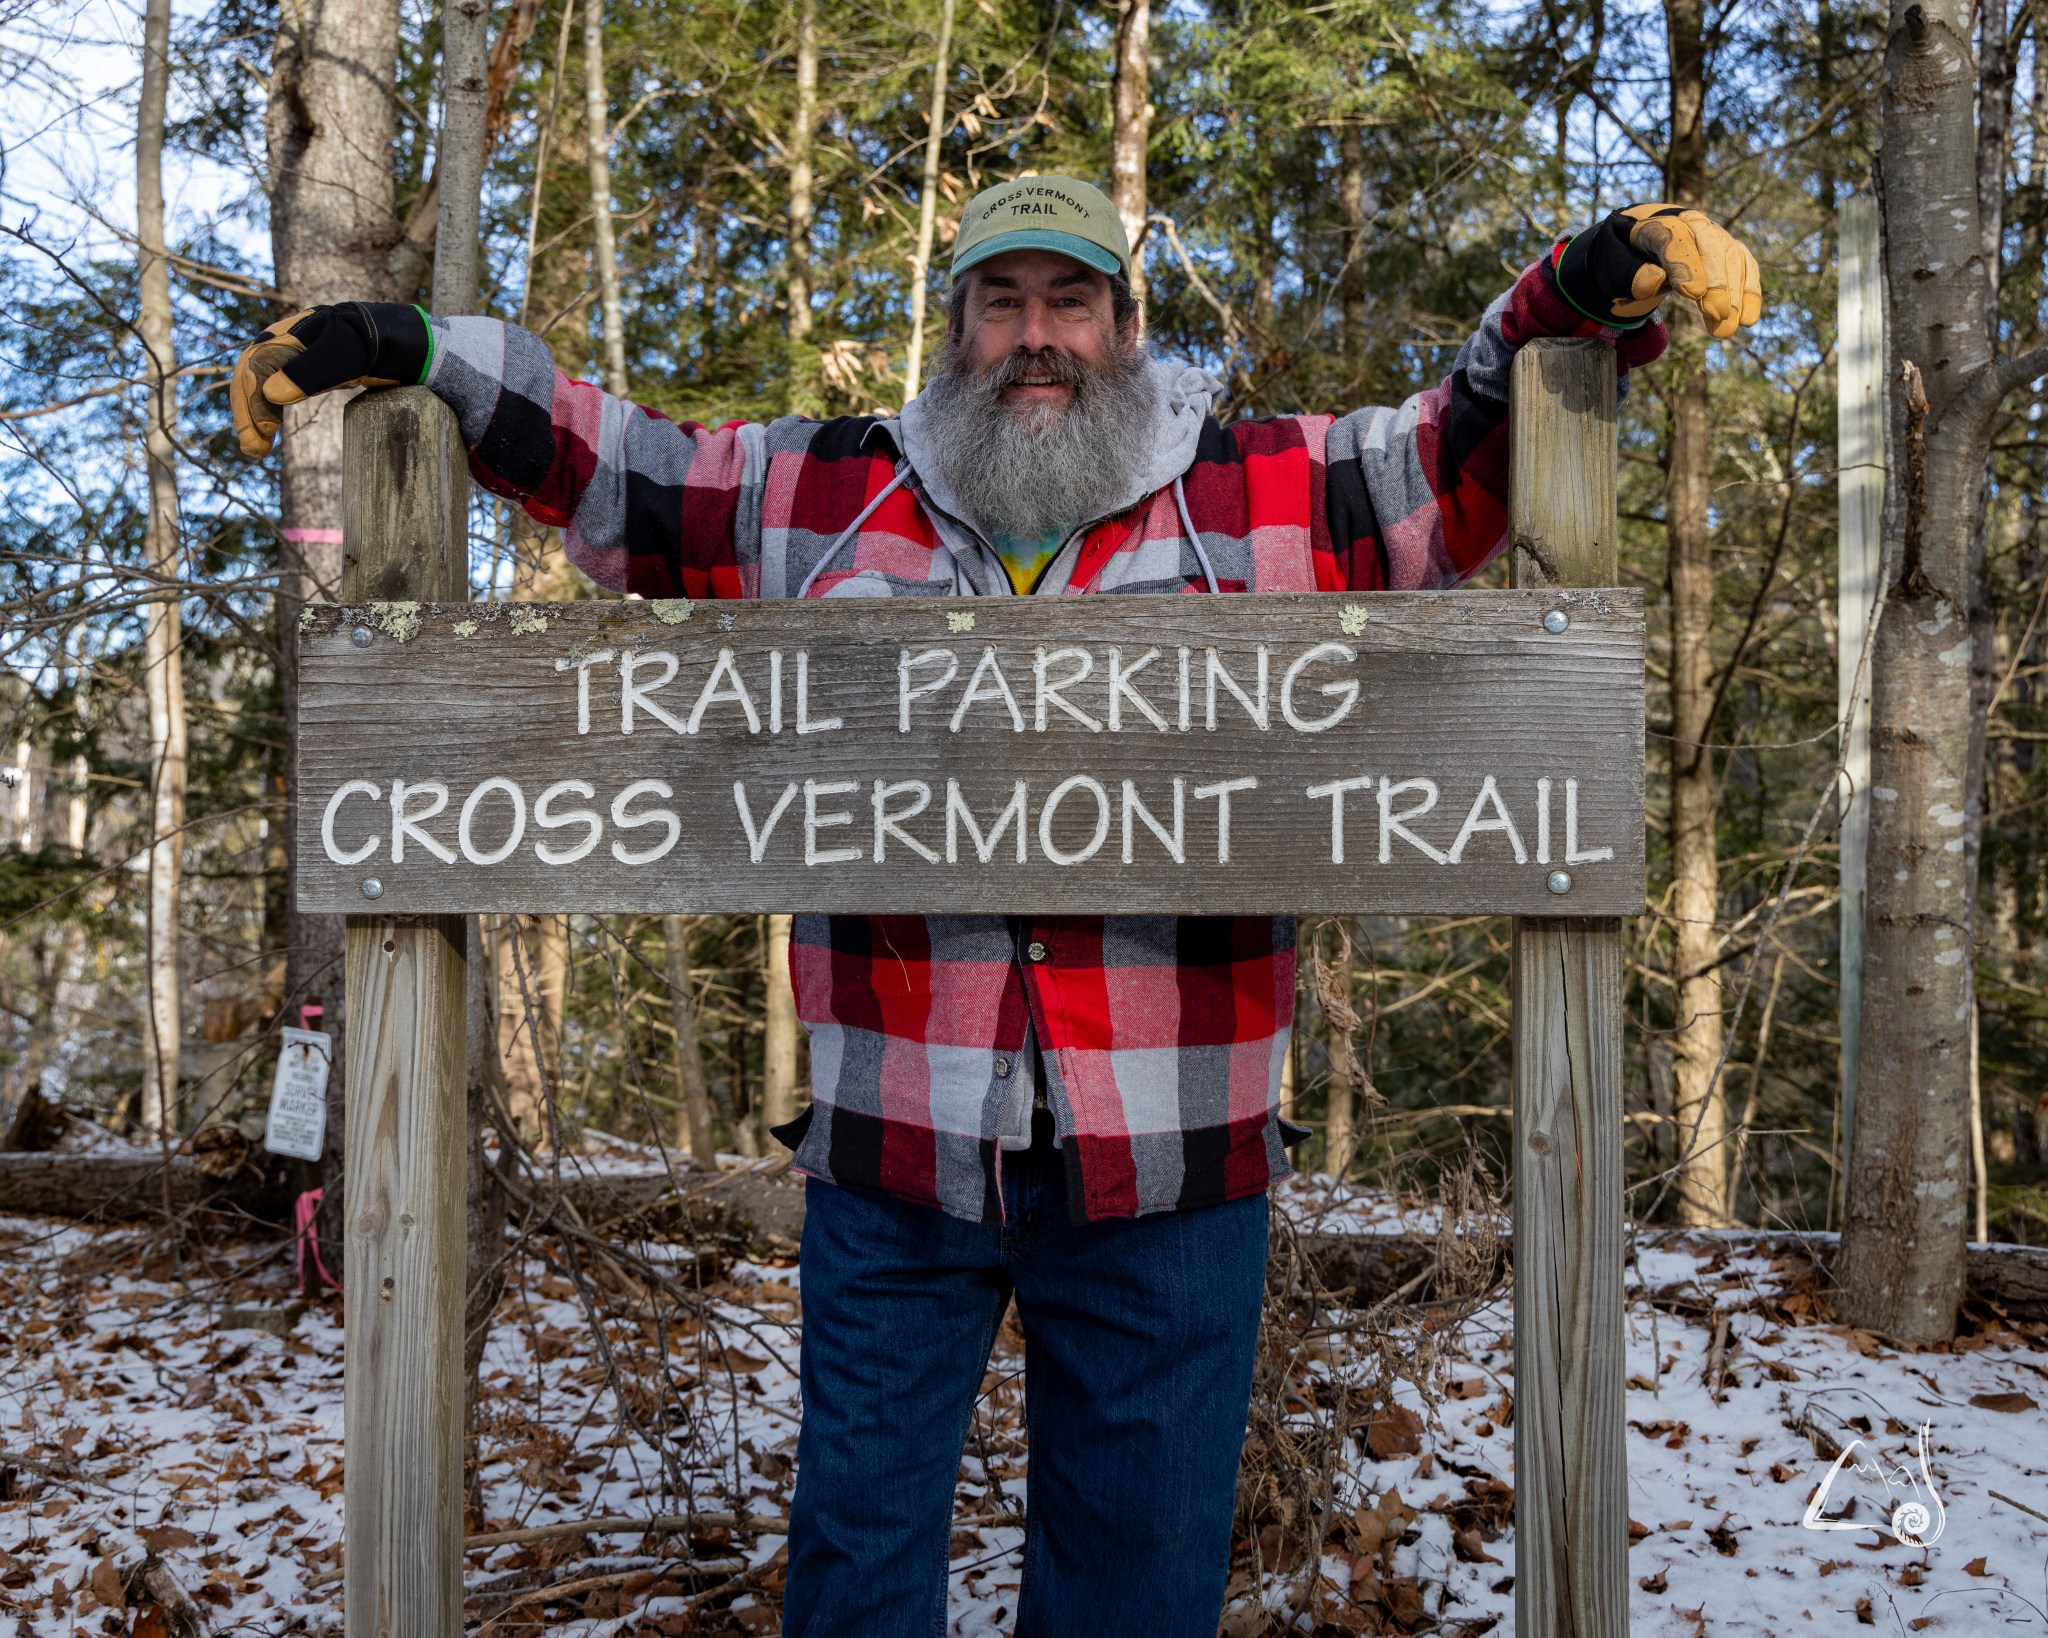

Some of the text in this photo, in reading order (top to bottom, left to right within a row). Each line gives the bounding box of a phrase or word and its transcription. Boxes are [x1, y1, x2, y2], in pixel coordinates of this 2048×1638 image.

[982, 187, 1090, 220] CROSS VERMONT
[1010, 202, 1058, 216] TRAIL
[554, 641, 1361, 735] TRAIL PARKING
[320, 774, 1616, 867] CROSS VERMONT TRAIL
